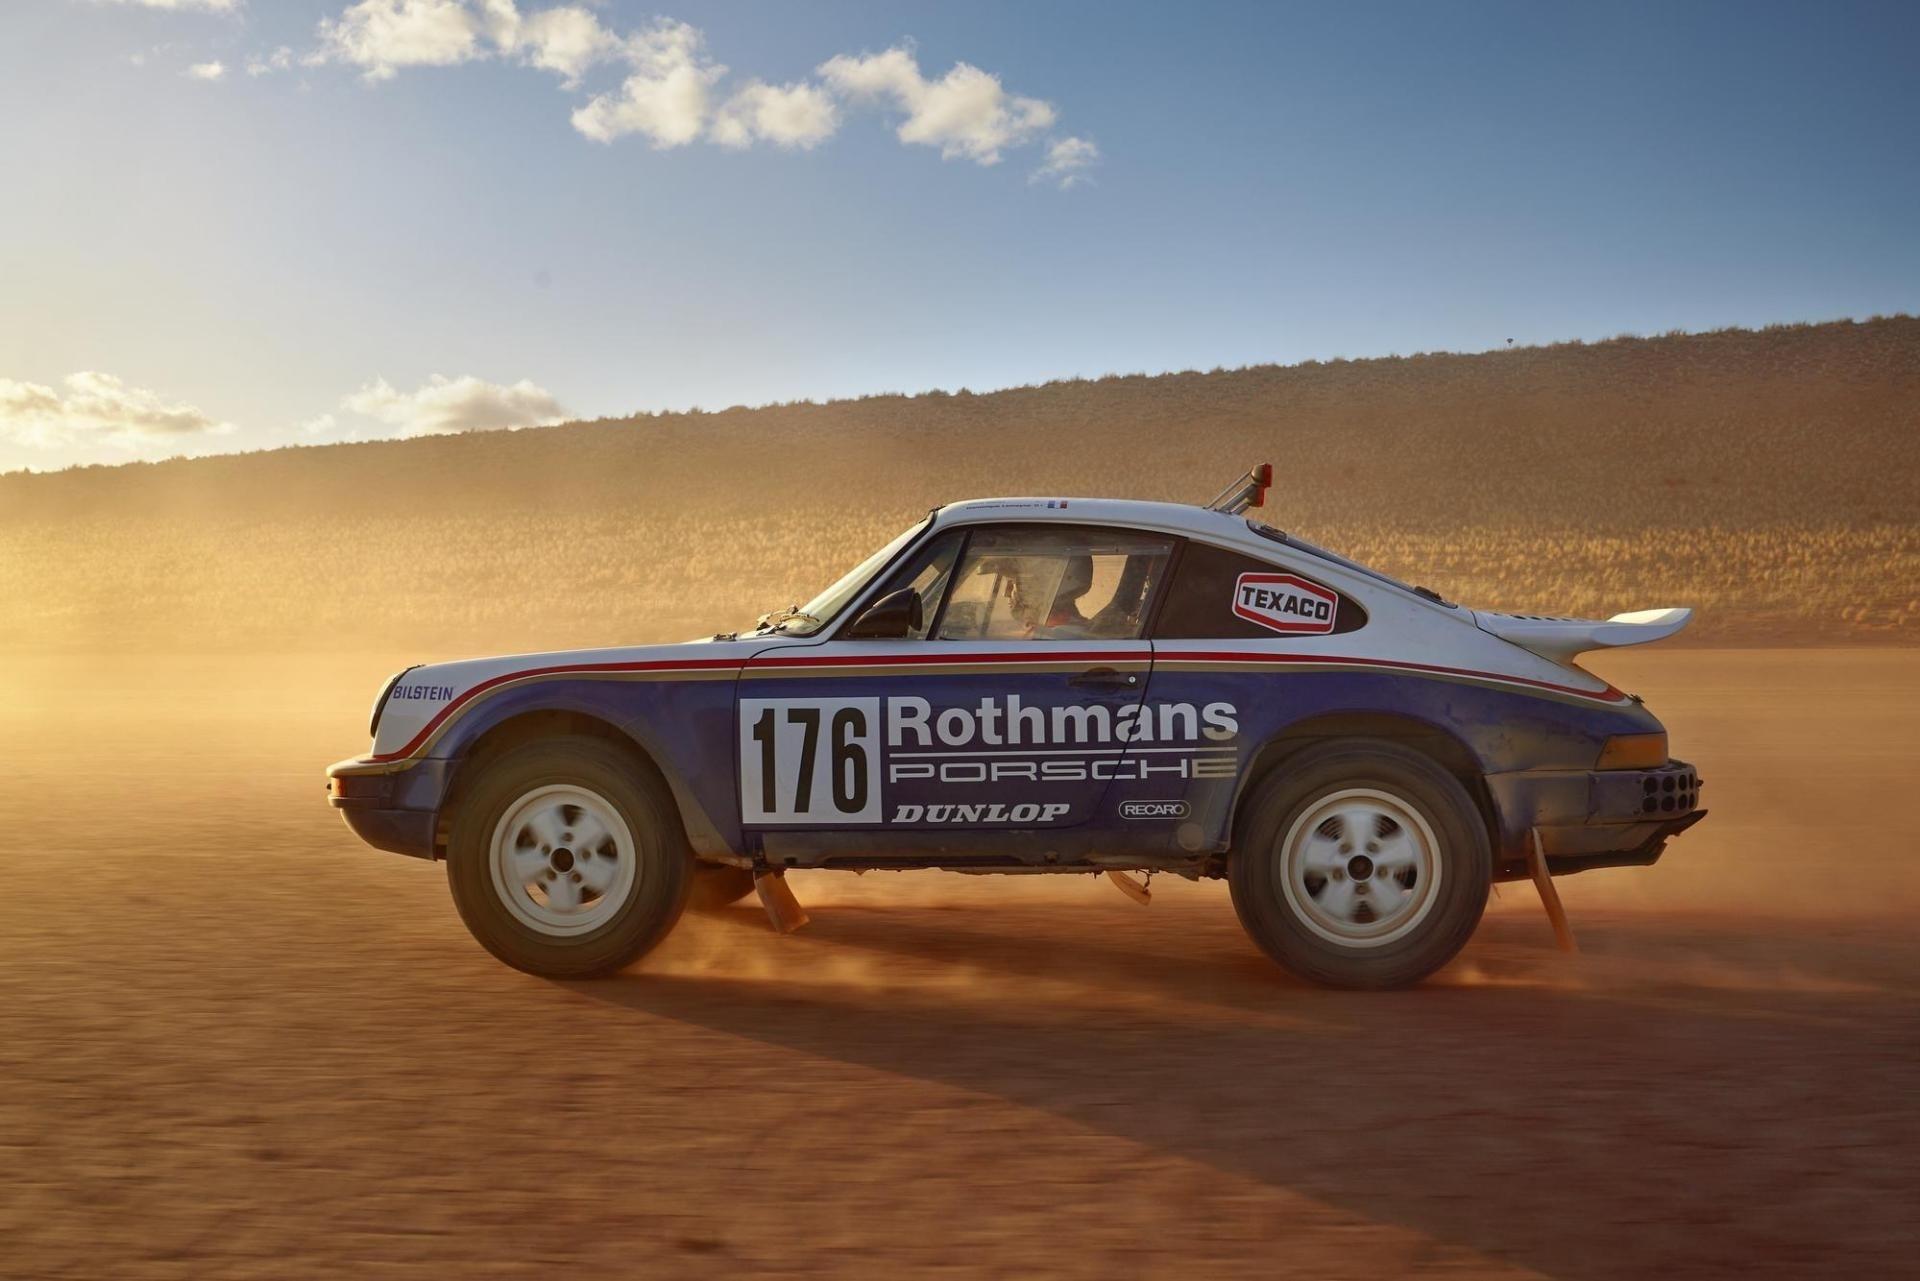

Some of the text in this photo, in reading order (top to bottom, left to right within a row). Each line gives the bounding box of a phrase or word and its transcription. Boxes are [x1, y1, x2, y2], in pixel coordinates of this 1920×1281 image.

[1243, 587, 1329, 620] TEXACO
[393, 685, 453, 701] BILSTEIN
[888, 694, 1238, 746] Rothmans
[753, 707, 868, 814] 176
[889, 758, 1237, 783] PORSCHE
[892, 803, 1070, 823] DUNLOP
[1125, 804, 1185, 815] RECARO
